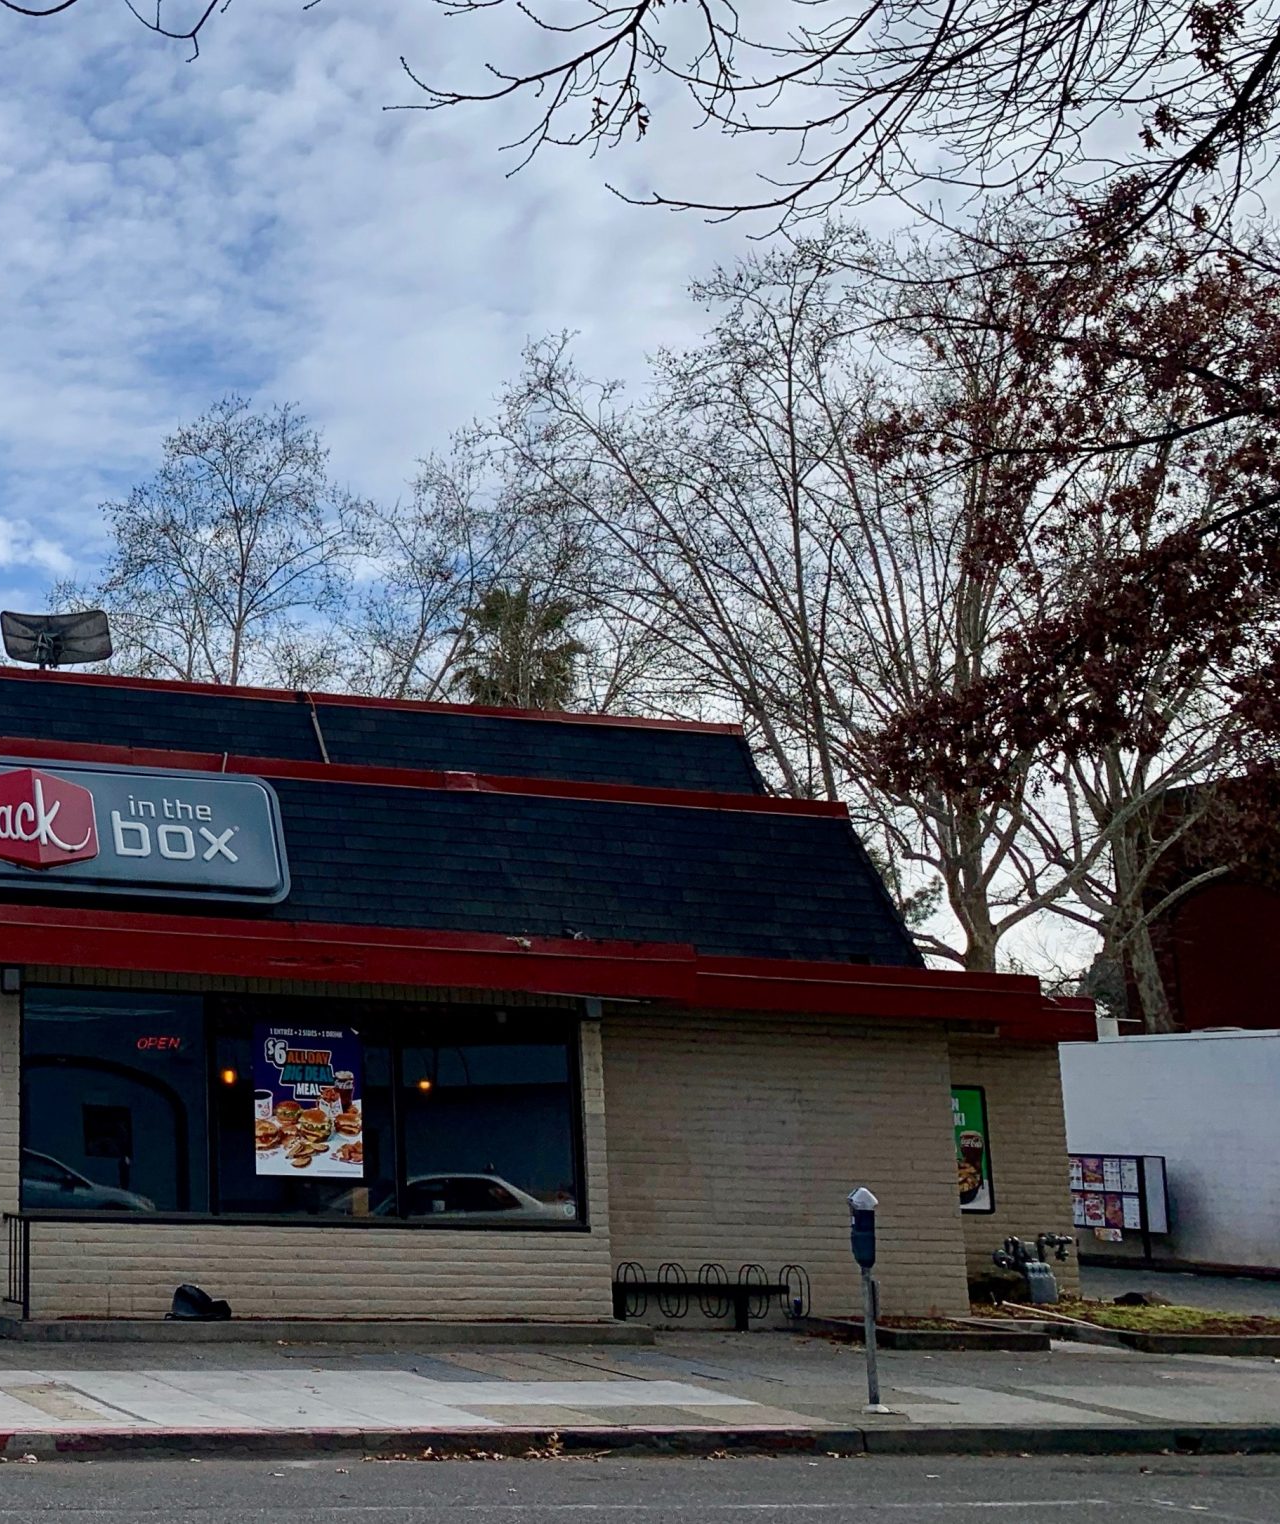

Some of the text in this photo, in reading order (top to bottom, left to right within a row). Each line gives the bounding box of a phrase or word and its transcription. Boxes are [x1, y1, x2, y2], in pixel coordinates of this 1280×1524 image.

[128, 795, 212, 823] in the
[111, 810, 239, 863] box
[137, 1037, 181, 1050] OPEN
[267, 1039, 287, 1065] $6
[282, 1065, 335, 1082] BIG DEAL
[296, 1082, 321, 1096] MEAL
